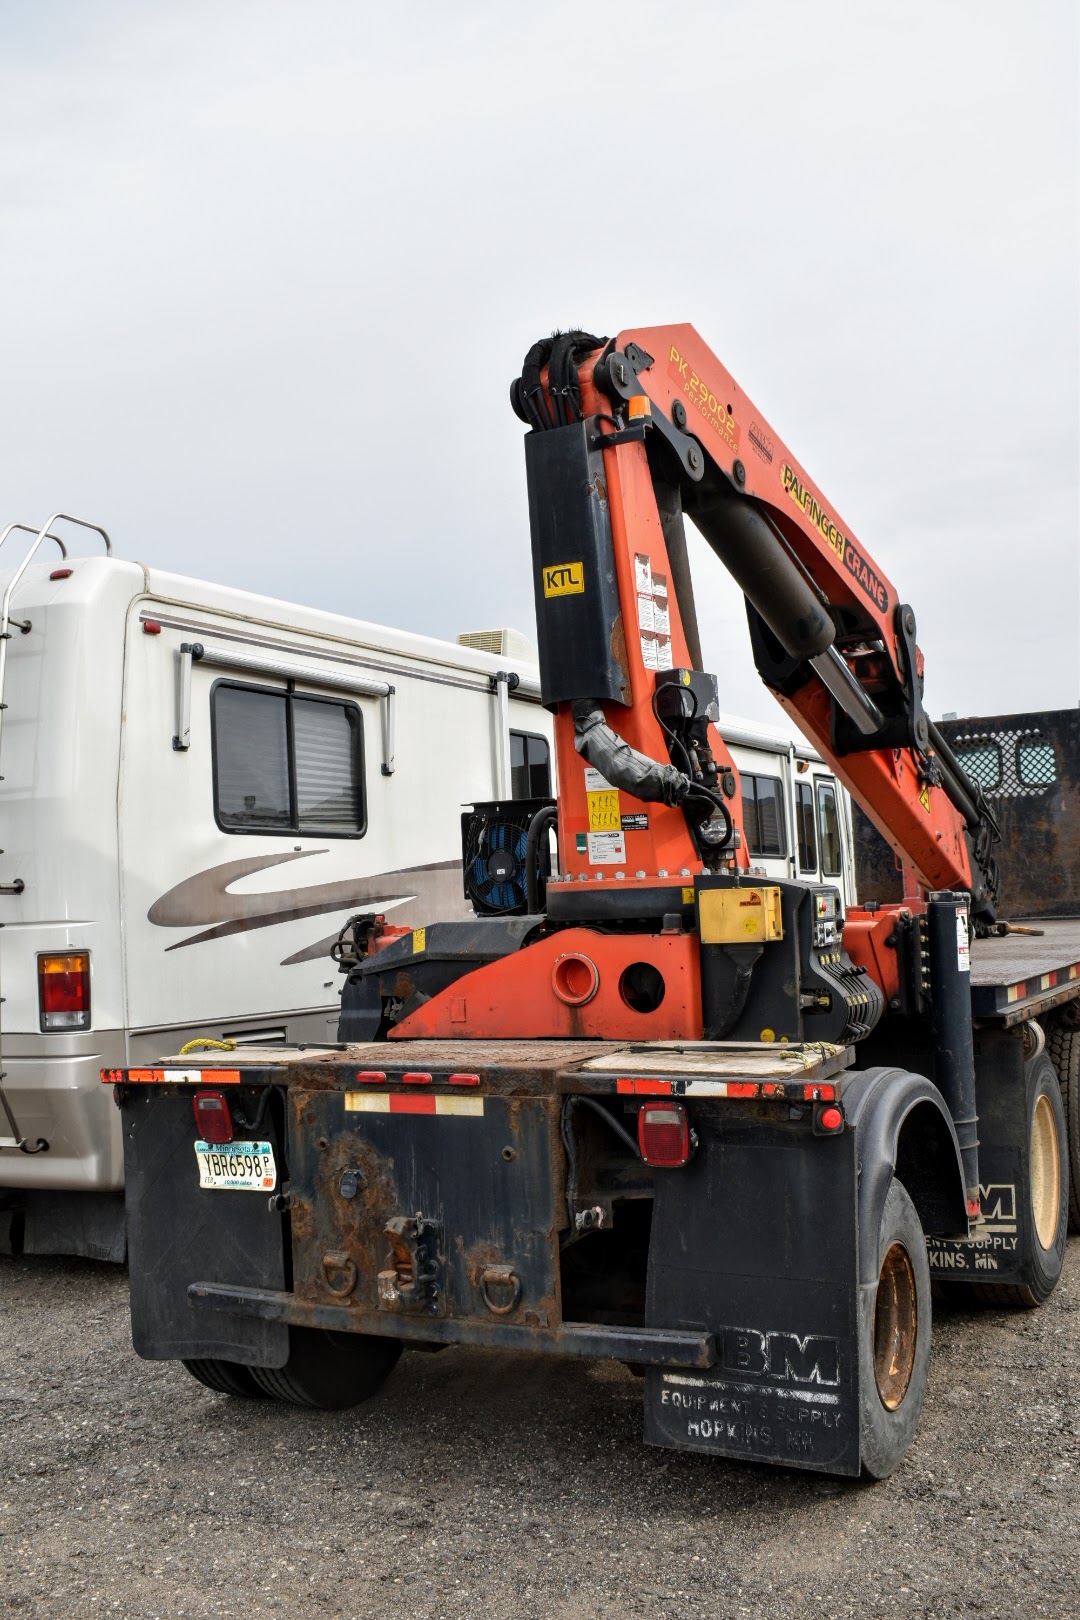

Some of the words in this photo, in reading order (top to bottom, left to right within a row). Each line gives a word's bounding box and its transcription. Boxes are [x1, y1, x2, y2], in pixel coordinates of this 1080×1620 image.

[669, 345, 689, 379] PK
[689, 370, 735, 435] 29002
[783, 465, 843, 555] PALFINGER
[546, 568, 579, 590] KTL
[845, 546, 886, 608] CRANE
[203, 1153, 263, 1178] YBR6598
[215, 1144, 251, 1152] Minnesota
[263, 1156, 269, 1167] P
[978, 1183, 1017, 1220] M
[929, 1251, 970, 1269] KINS,
[974, 1253, 998, 1270] MN
[720, 1325, 841, 1387] BM
[660, 1389, 751, 1416] EQUIPMENT
[775, 1405, 846, 1428] SUPPLY
